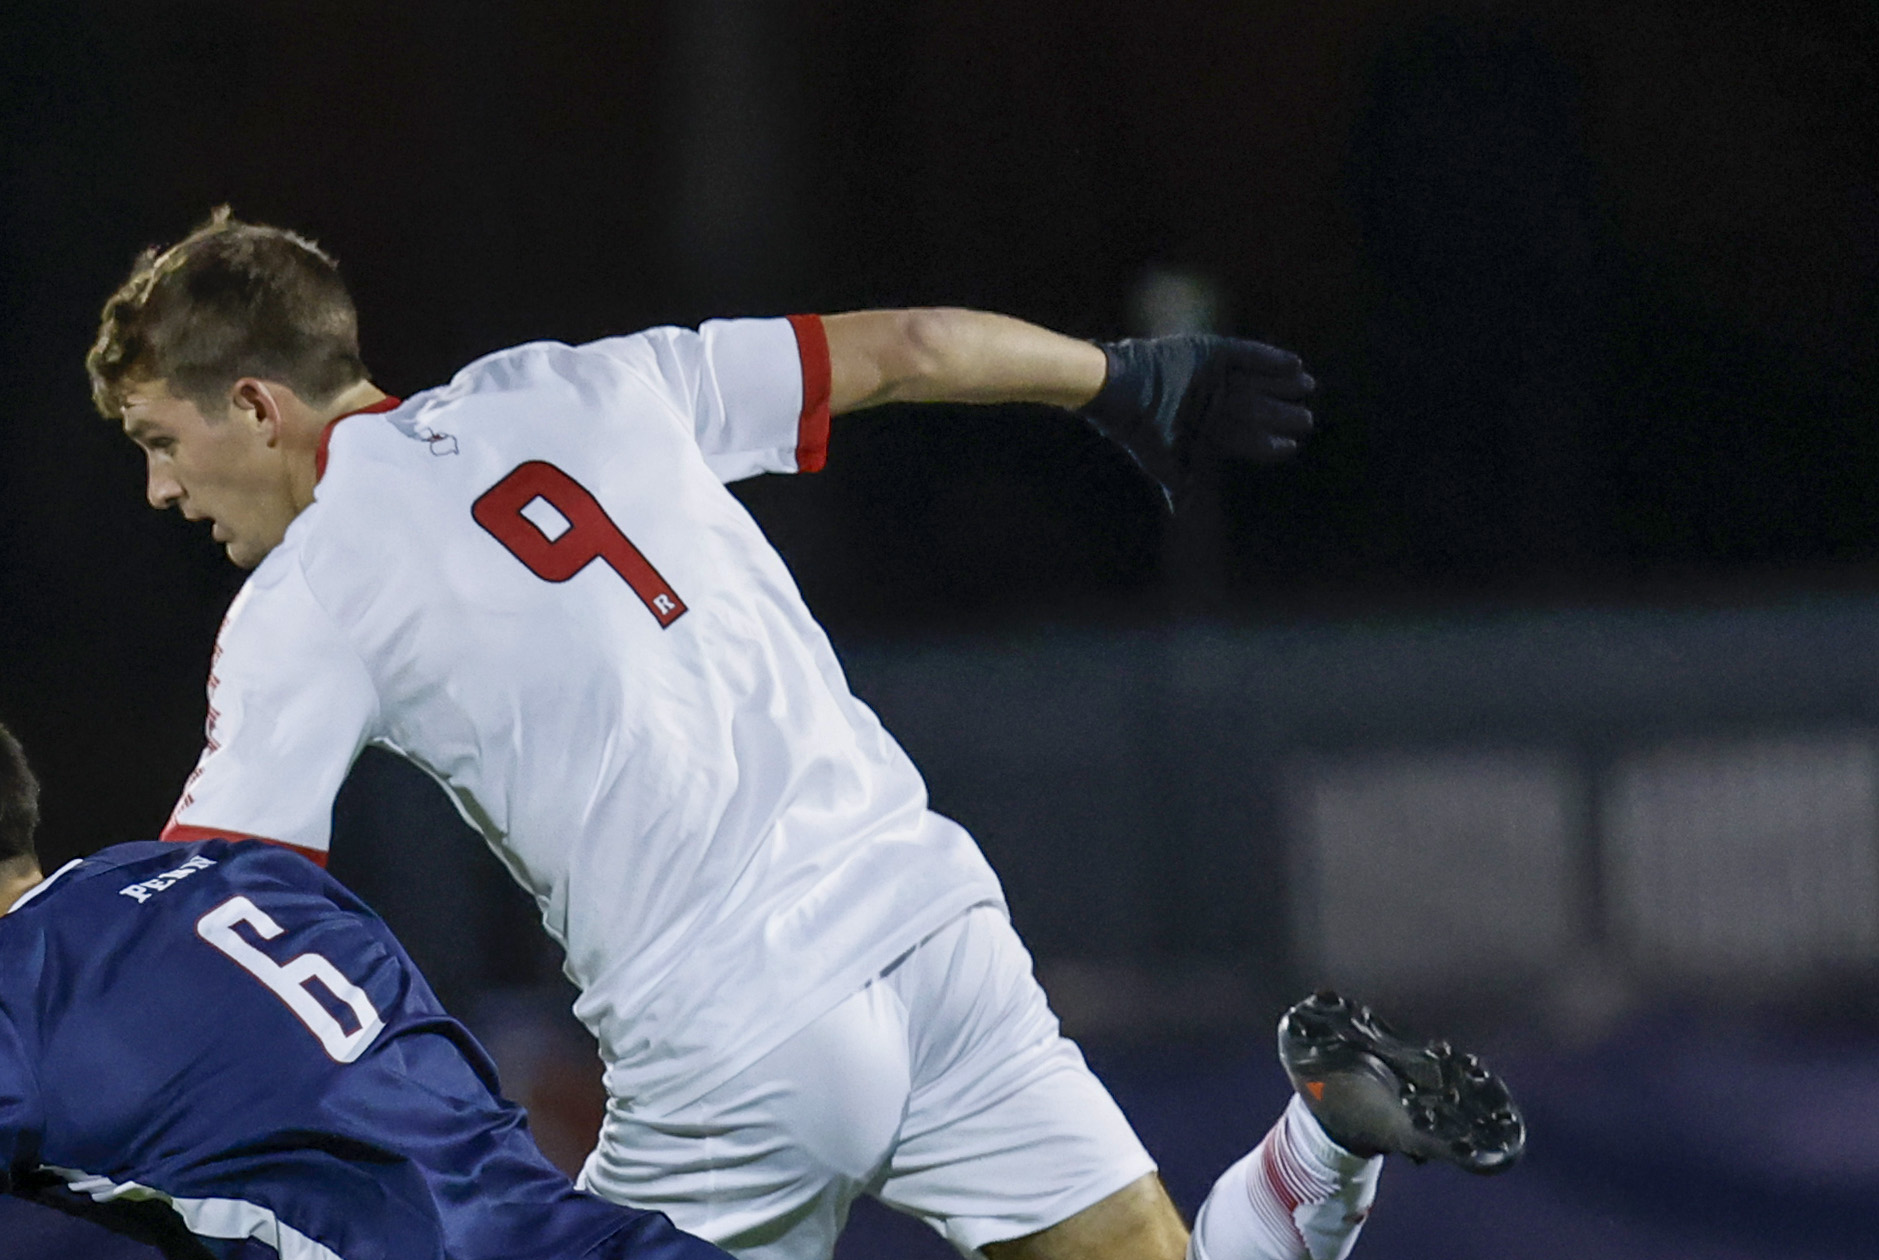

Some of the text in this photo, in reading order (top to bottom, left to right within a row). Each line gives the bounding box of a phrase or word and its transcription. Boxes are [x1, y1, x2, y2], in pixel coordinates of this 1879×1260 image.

[471, 460, 688, 629] 9
[652, 593, 676, 615] R
[194, 895, 386, 1063] 6
